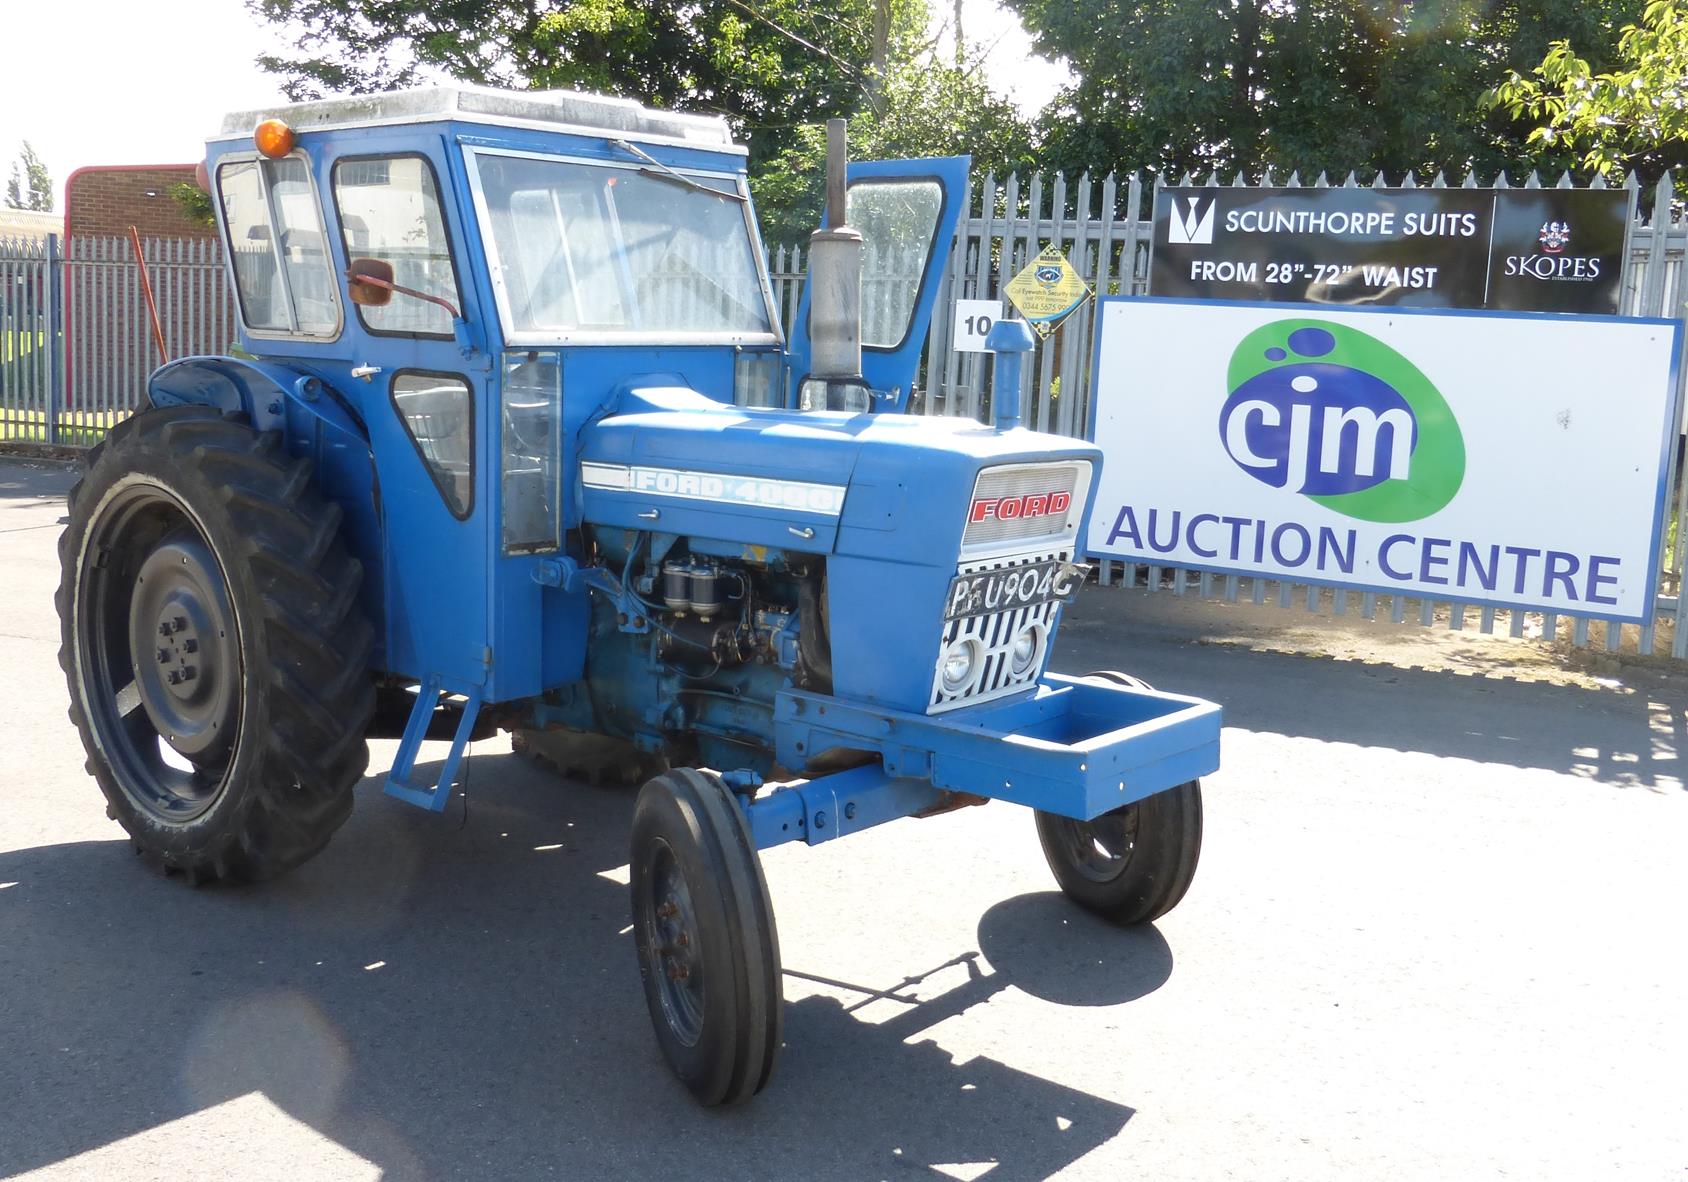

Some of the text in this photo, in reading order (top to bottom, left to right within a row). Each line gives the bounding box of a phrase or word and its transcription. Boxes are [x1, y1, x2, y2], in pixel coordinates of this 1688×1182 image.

[1225, 210, 1477, 237] SCUNTHORPE SUITS
[1190, 260, 1257, 283] FROM
[1362, 265, 1438, 289] WAIST
[1504, 254, 1600, 280] SKOPES
[1047, 289, 1069, 298] Security
[964, 315, 992, 337] 10
[1225, 375, 1414, 494] cjm
[636, 470, 834, 511] FORD 4000
[969, 491, 1072, 523] FORD
[1105, 505, 1622, 606] AUCTION CENTRE
